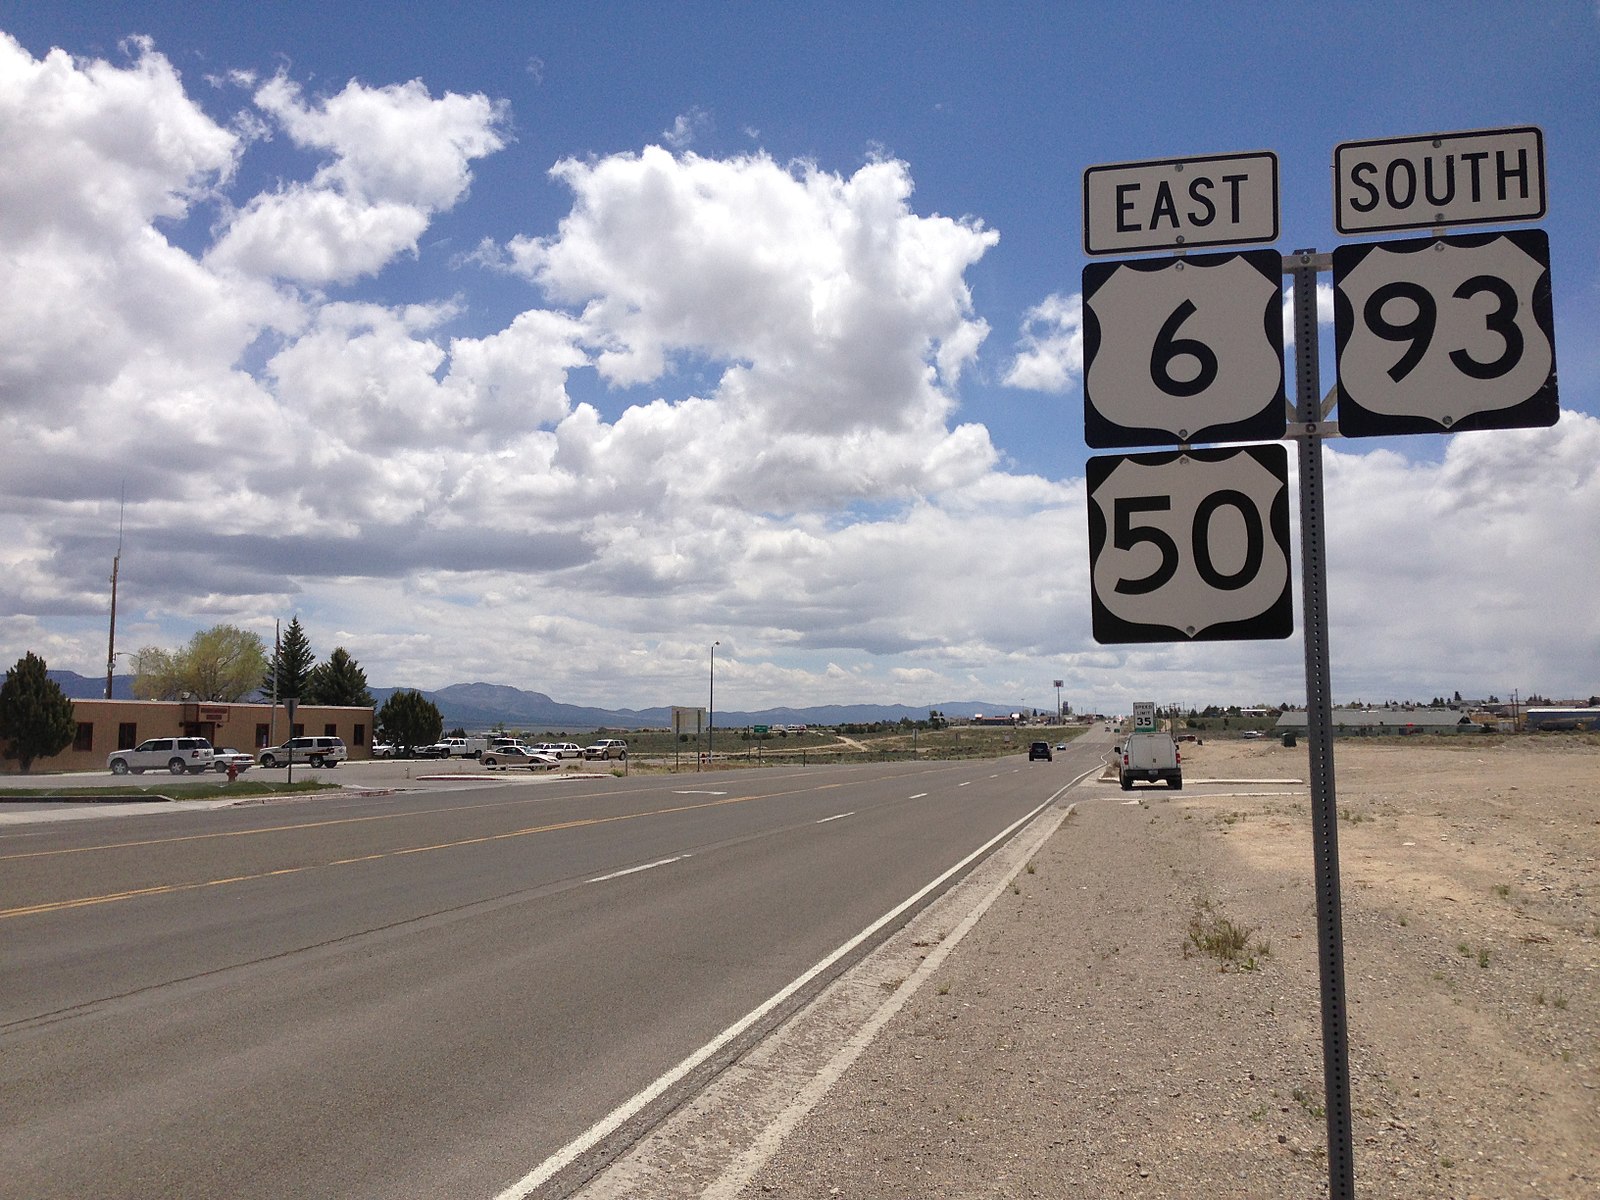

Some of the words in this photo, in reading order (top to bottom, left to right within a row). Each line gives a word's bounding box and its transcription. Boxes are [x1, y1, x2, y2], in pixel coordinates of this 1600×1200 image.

[1116, 174, 1249, 233] EAST
[1350, 149, 1530, 213] SOUTH
[1150, 298, 1219, 397] 6
[1363, 275, 1524, 384] 93
[1113, 489, 1264, 596] 50
[1136, 717, 1152, 726] 35
